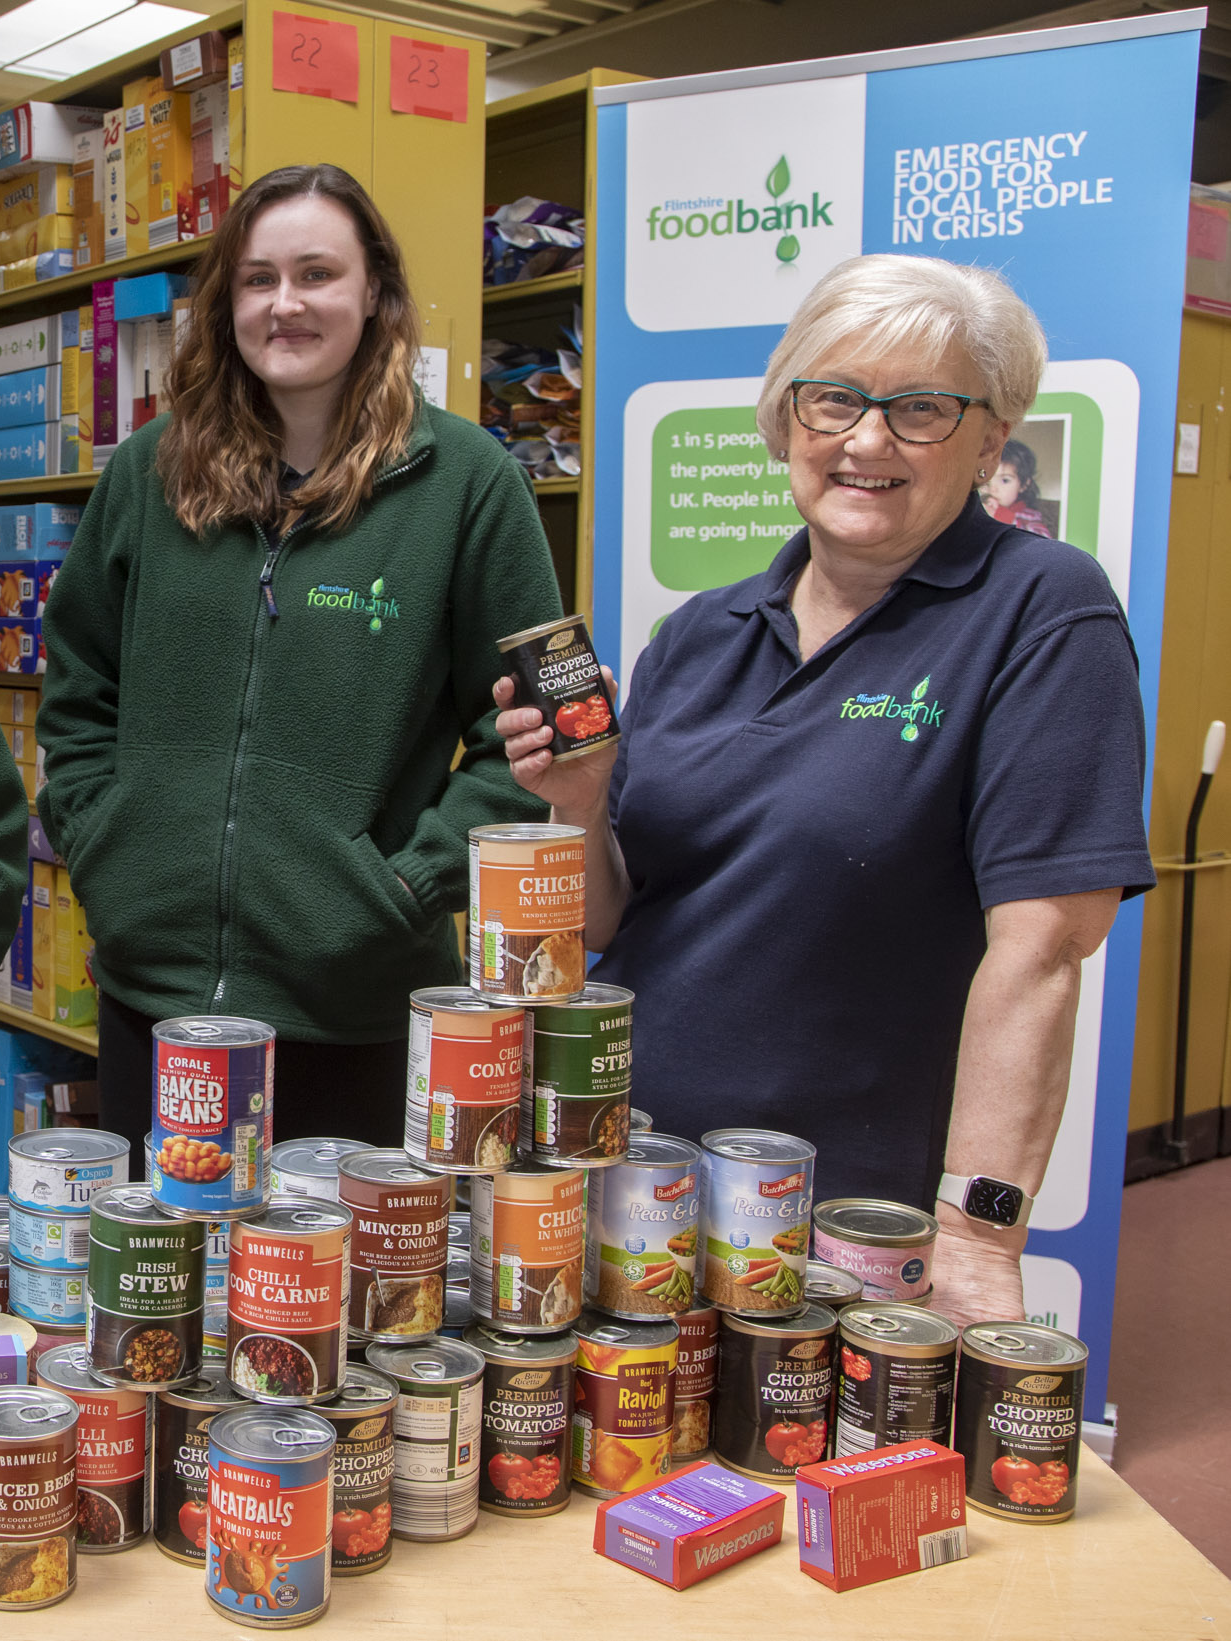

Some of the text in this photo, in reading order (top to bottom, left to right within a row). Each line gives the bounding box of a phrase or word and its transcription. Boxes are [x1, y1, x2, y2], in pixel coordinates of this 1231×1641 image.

[291, 33, 322, 69] 22
[408, 55, 440, 88] 23
[895, 131, 1087, 173] EMERGENCY
[894, 160, 1053, 197] FOOD FOR
[664, 197, 724, 211] Flintshire
[893, 177, 1113, 221] LOCAL PEOPLE
[646, 192, 834, 241] foodbank
[892, 210, 1024, 244] IN CRISIS
[671, 432, 766, 450] 1 in 5 peop
[670, 459, 790, 480] the poverty lin
[670, 490, 779, 510] UK. People in
[669, 526, 696, 538] are
[699, 522, 747, 542] going
[307, 588, 400, 617] foodbank
[540, 643, 586, 665] PREMIUM
[538, 652, 594, 679] CHOPPED
[538, 664, 599, 693] TOMATOES
[839, 695, 945, 728] foodbank
[519, 894, 573, 906] IN WHITE
[160, 1068, 225, 1082] PREMIUM QUALITY
[168, 1056, 211, 1074] CORALE
[469, 1063, 505, 1078] CON
[160, 1075, 224, 1102] BAKED
[159, 1097, 224, 1125] BEANS
[81, 1169, 111, 1180] Osprey
[656, 1177, 694, 1198] Batchelors
[761, 1176, 803, 1195] Batchelors
[387, 1194, 438, 1209] BRAMWELLS
[734, 1198, 794, 1218] Peas &
[629, 1202, 687, 1222] Peas &
[358, 1214, 449, 1237] MINCED BEEF
[129, 1237, 186, 1249] BRAMWELLS
[248, 1243, 304, 1261] BRAMWELLS
[383, 1234, 438, 1250] & ONION
[841, 1249, 866, 1261] PINK
[136, 1262, 177, 1274] IRISH
[840, 1259, 893, 1275] SALMON
[120, 1273, 190, 1293] STEW
[248, 1268, 301, 1287] CHILLI
[230, 1273, 330, 1304] CON CARNE
[120, 1296, 138, 1304] IDEAL
[163, 1296, 187, 1304] HEARTY
[152, 1302, 188, 1311] CASSEROLE
[625, 1366, 665, 1377] BRAMWELLS
[775, 1356, 830, 1372] PREMIUM
[640, 1379, 652, 1387] Beef
[767, 1367, 831, 1387] CHOPPED
[1023, 1381, 1051, 1389] Ricetta
[1034, 1376, 1054, 1384] Bella
[496, 1388, 560, 1401] PREMIUM
[618, 1384, 667, 1410] Ravioli
[761, 1380, 831, 1402] TOMATOES
[1002, 1390, 1070, 1407] PREMIUM
[489, 1401, 564, 1418] CHOPPED
[994, 1402, 1074, 1422] CHOPPED
[483, 1414, 567, 1434] TOMATOES
[618, 1415, 666, 1427] TOMATO SAUCE
[988, 1415, 1076, 1438] TOMATOES
[335, 1433, 393, 1454] PREMIUM
[0, 1451, 57, 1467] BRAMWELLS
[821, 1447, 937, 1477] Watersons
[45, 1468, 75, 1492] BEEF
[224, 1468, 271, 1489] BRAMWELLS
[13, 1493, 60, 1512] ONION
[211, 1479, 295, 1528] MEATBALLS
[649, 1495, 706, 1522] SARDINES
[216, 1515, 282, 1541] IN TOMATO SAUCE
[694, 1520, 774, 1570] Watersons
